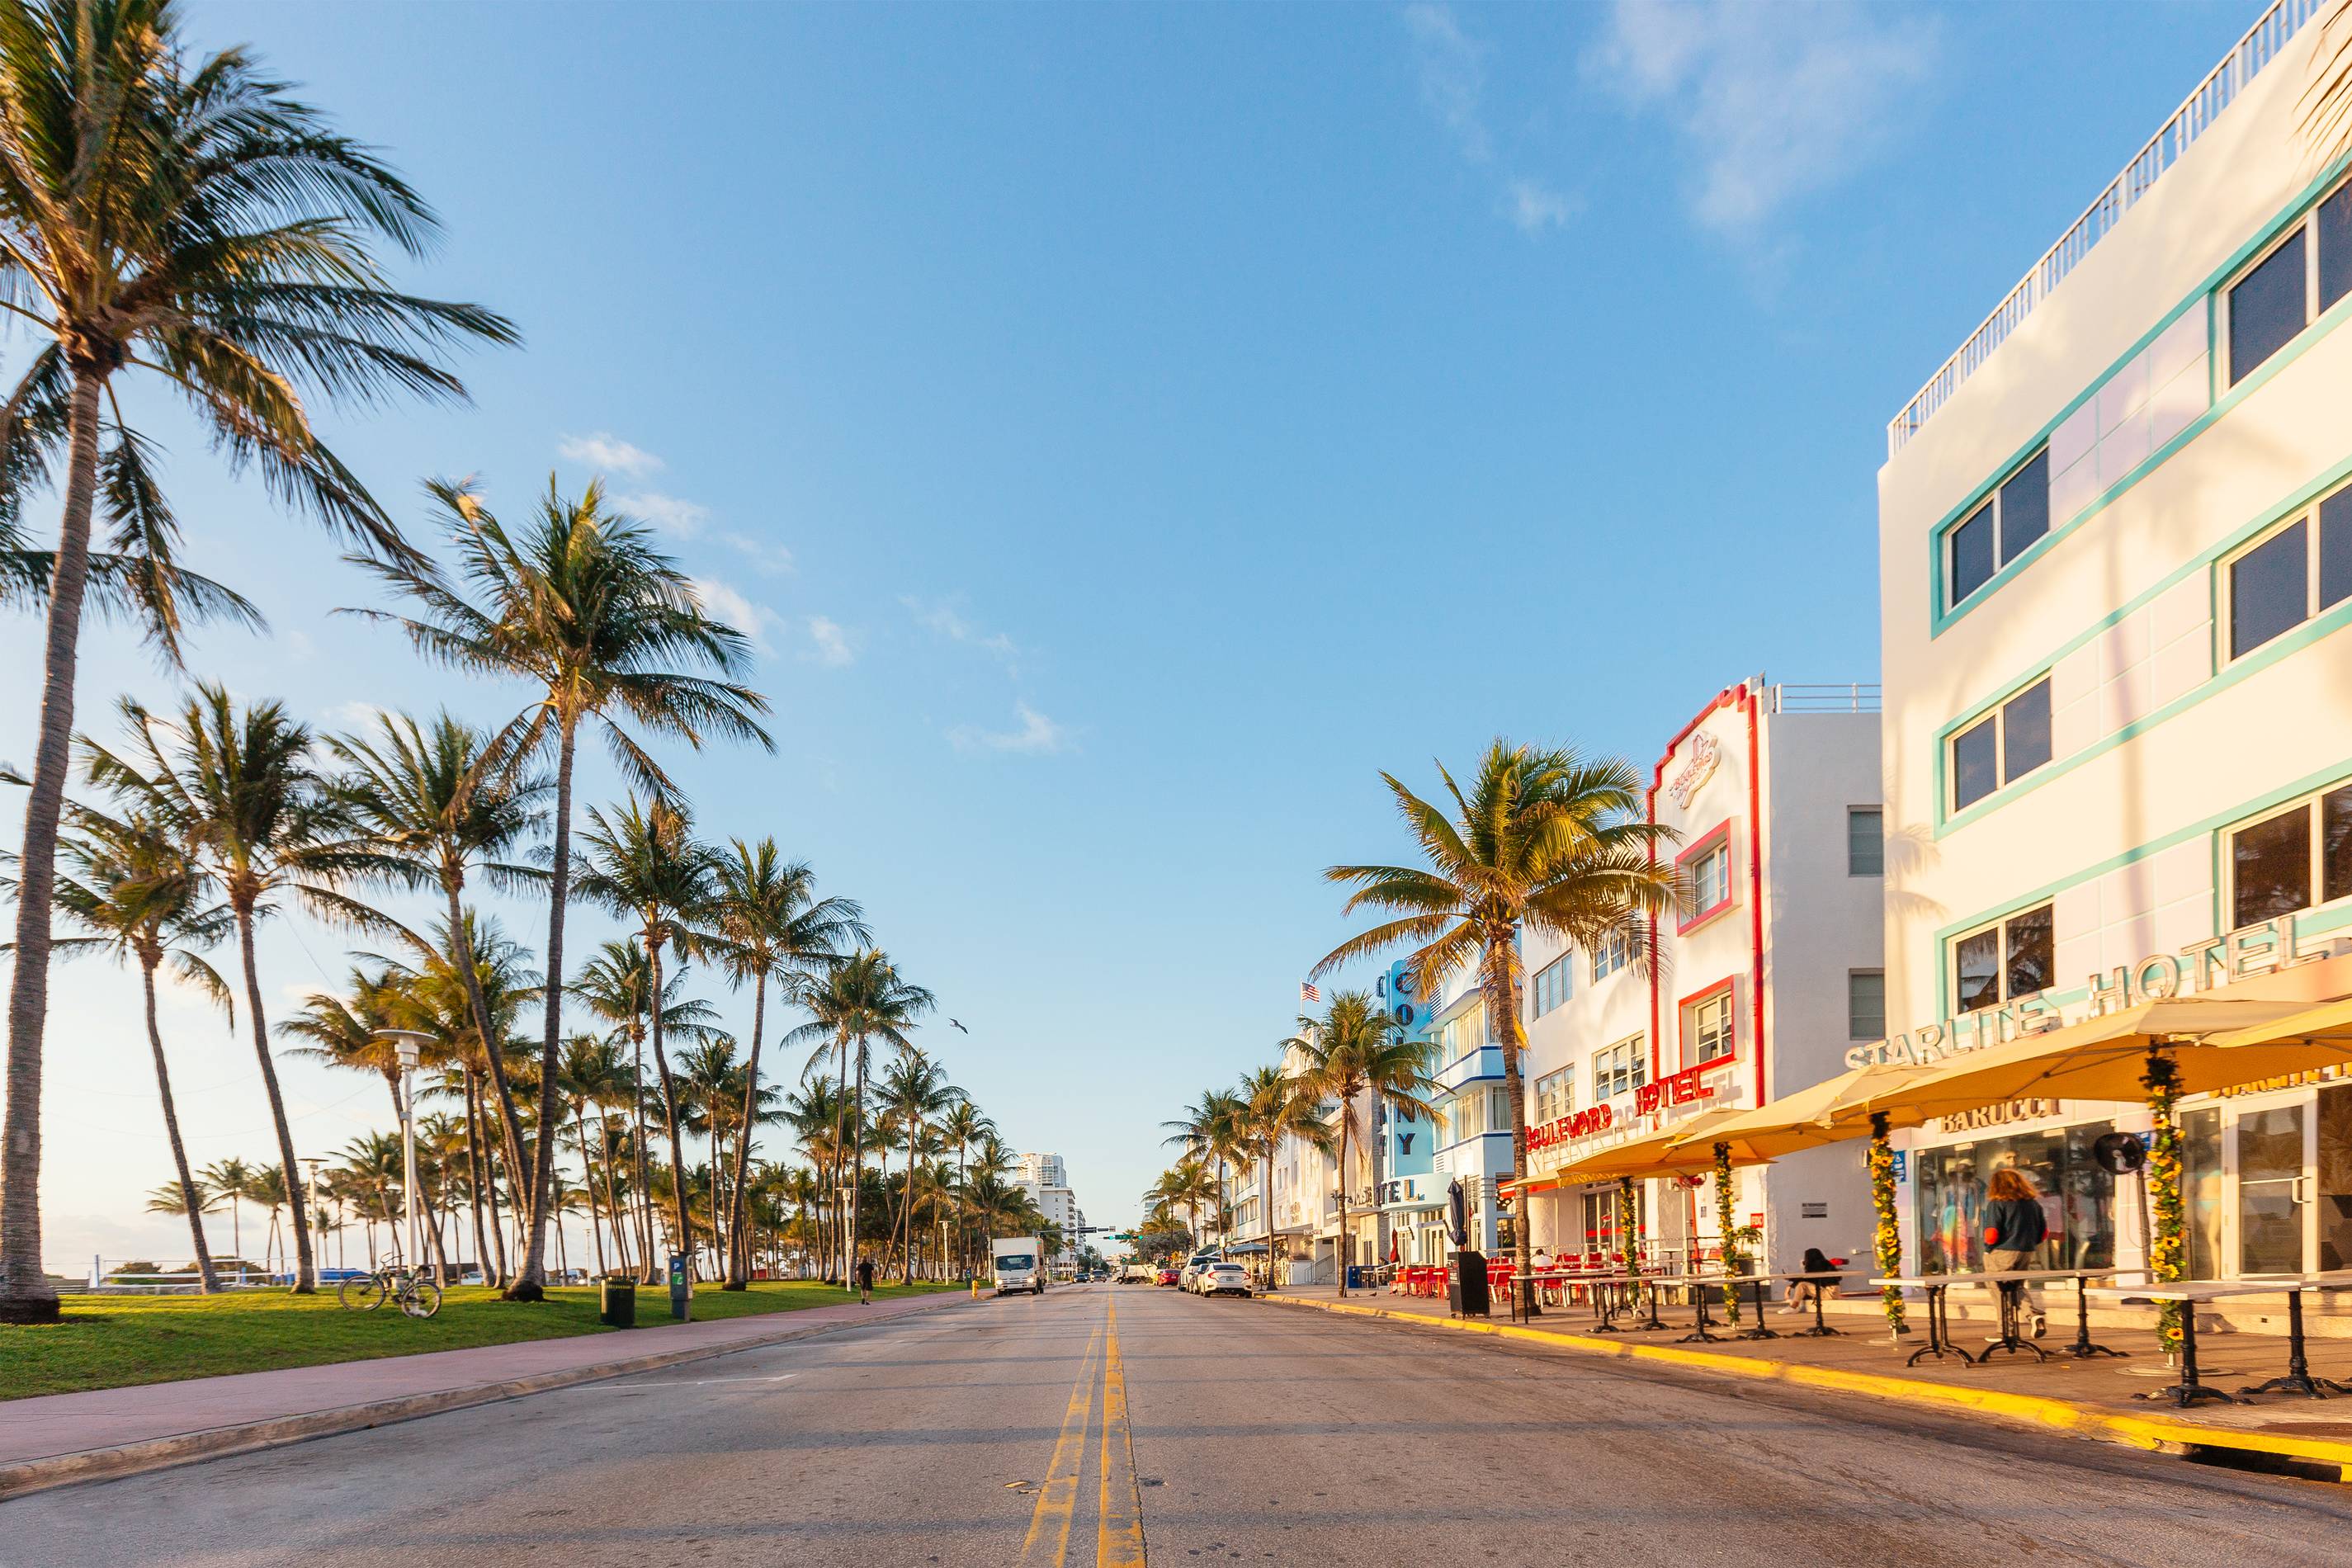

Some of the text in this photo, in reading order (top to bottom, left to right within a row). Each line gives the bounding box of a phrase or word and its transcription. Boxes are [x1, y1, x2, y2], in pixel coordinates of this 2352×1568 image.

[1844, 914, 2328, 1070] STARLITE HOTEL
[1524, 1070, 1714, 1151] BOULEVARD HOTEL
[1939, 1098, 2062, 1134] BARUCCI
